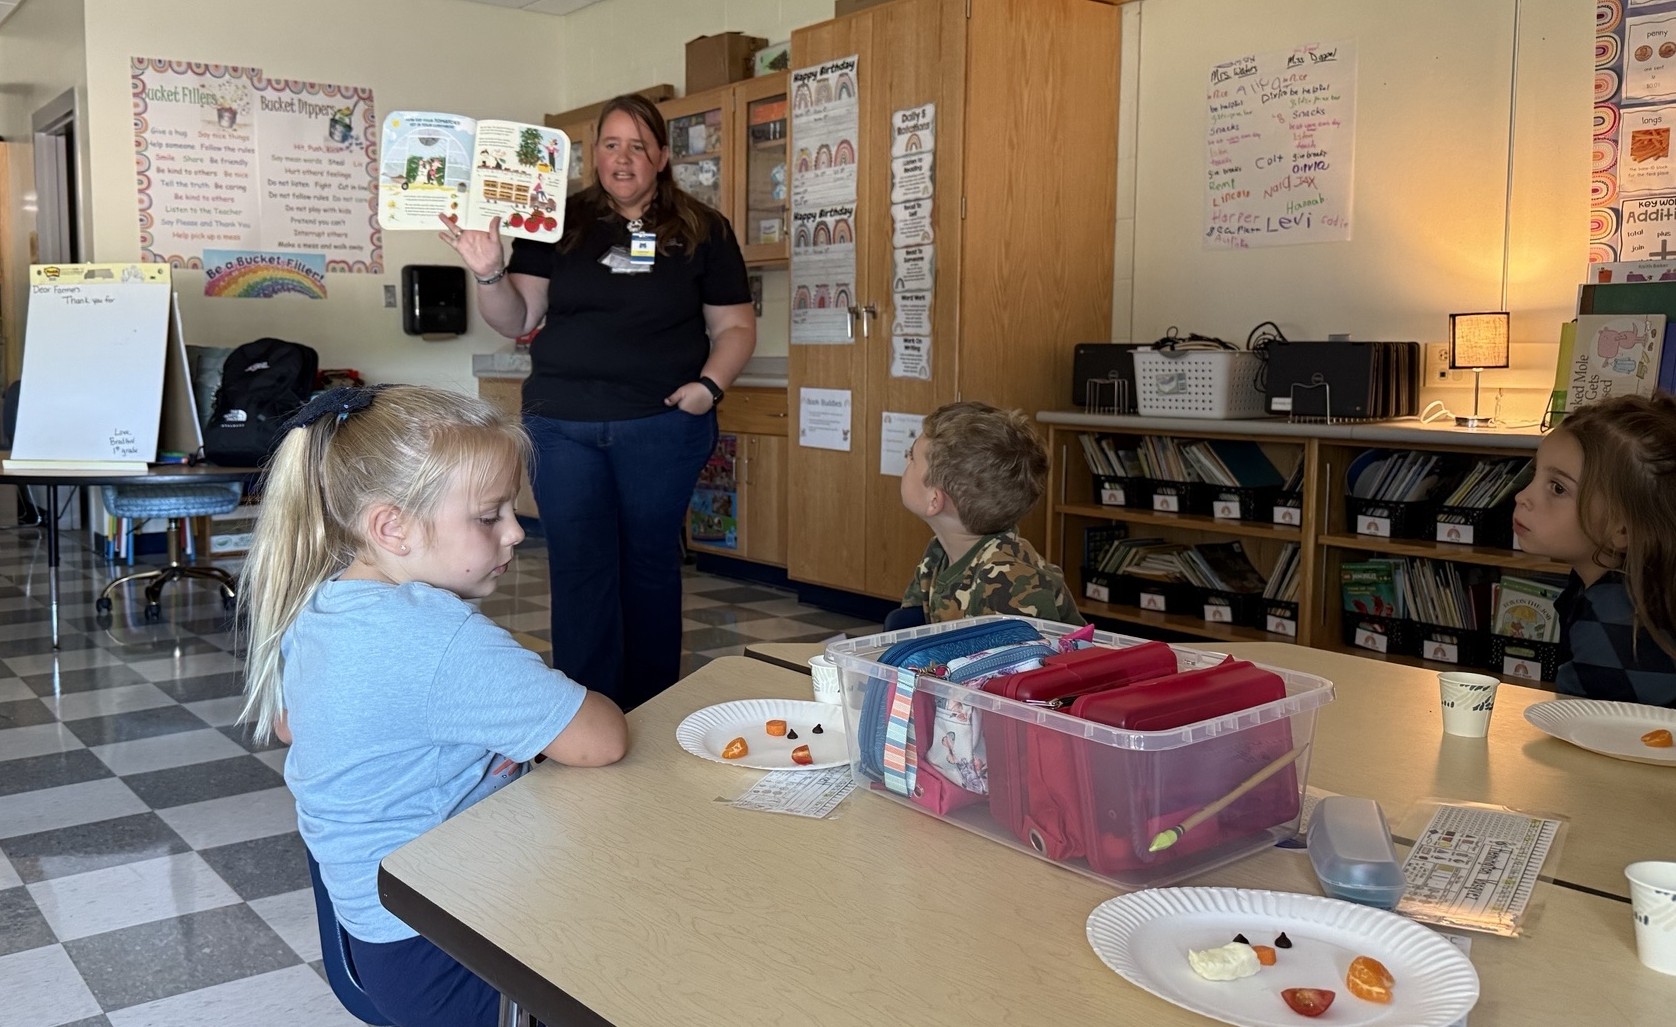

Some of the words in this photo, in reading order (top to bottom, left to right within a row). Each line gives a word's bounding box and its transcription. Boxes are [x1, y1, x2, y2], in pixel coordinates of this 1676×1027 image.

[1646, 30, 1668, 38] penny
[794, 70, 818, 83] Happy
[820, 60, 854, 76] Birthday
[144, 85, 180, 104] ucket
[182, 86, 218, 105] Fillers
[260, 96, 296, 114] Bucket
[298, 98, 336, 119] Dippers
[902, 111, 920, 123] Daily
[175, 129, 188, 138] hug
[228, 132, 250, 141] things
[201, 143, 222, 151] Follow
[224, 144, 236, 152] the
[238, 145, 255, 154] rules
[221, 157, 248, 167] friendly
[1255, 155, 1283, 169] Colt
[194, 168, 217, 177] others
[225, 184, 247, 192] caring
[185, 193, 200, 201] kind
[794, 211, 817, 222] Happy
[818, 206, 853, 218] Birthday
[1266, 213, 1312, 232] Levi
[206, 266, 223, 280] Be
[226, 262, 234, 270] a
[236, 254, 281, 268] Bucket
[33, 285, 51, 294] Dear
[62, 296, 90, 304] Thank
[105, 295, 115, 303] for
[1574, 354, 1589, 384] Mole
[1585, 374, 1600, 400] Gets
[121, 446, 138, 457] grade
